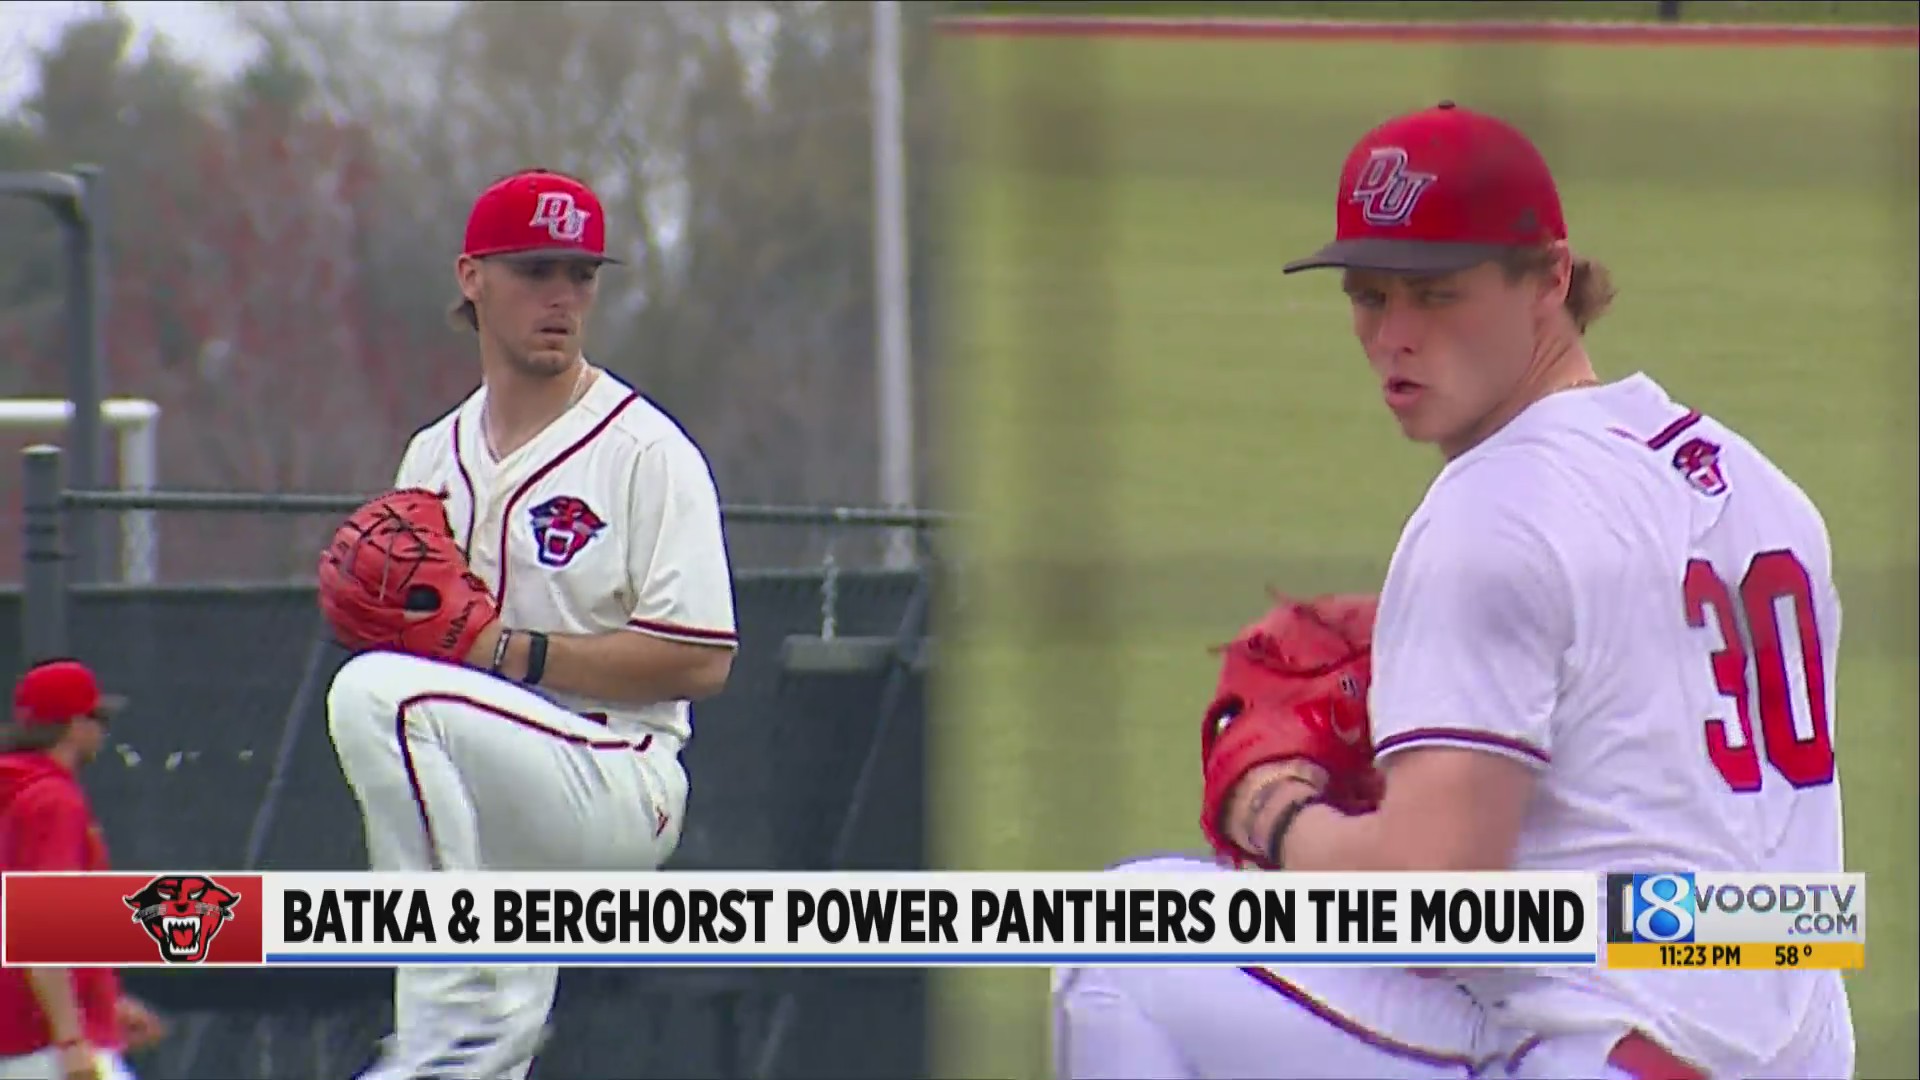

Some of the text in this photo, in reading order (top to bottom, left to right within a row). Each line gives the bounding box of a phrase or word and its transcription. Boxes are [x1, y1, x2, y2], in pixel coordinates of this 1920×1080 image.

[529, 191, 591, 241] DU
[1353, 147, 1438, 226] DU
[1683, 548, 1834, 792] 30
